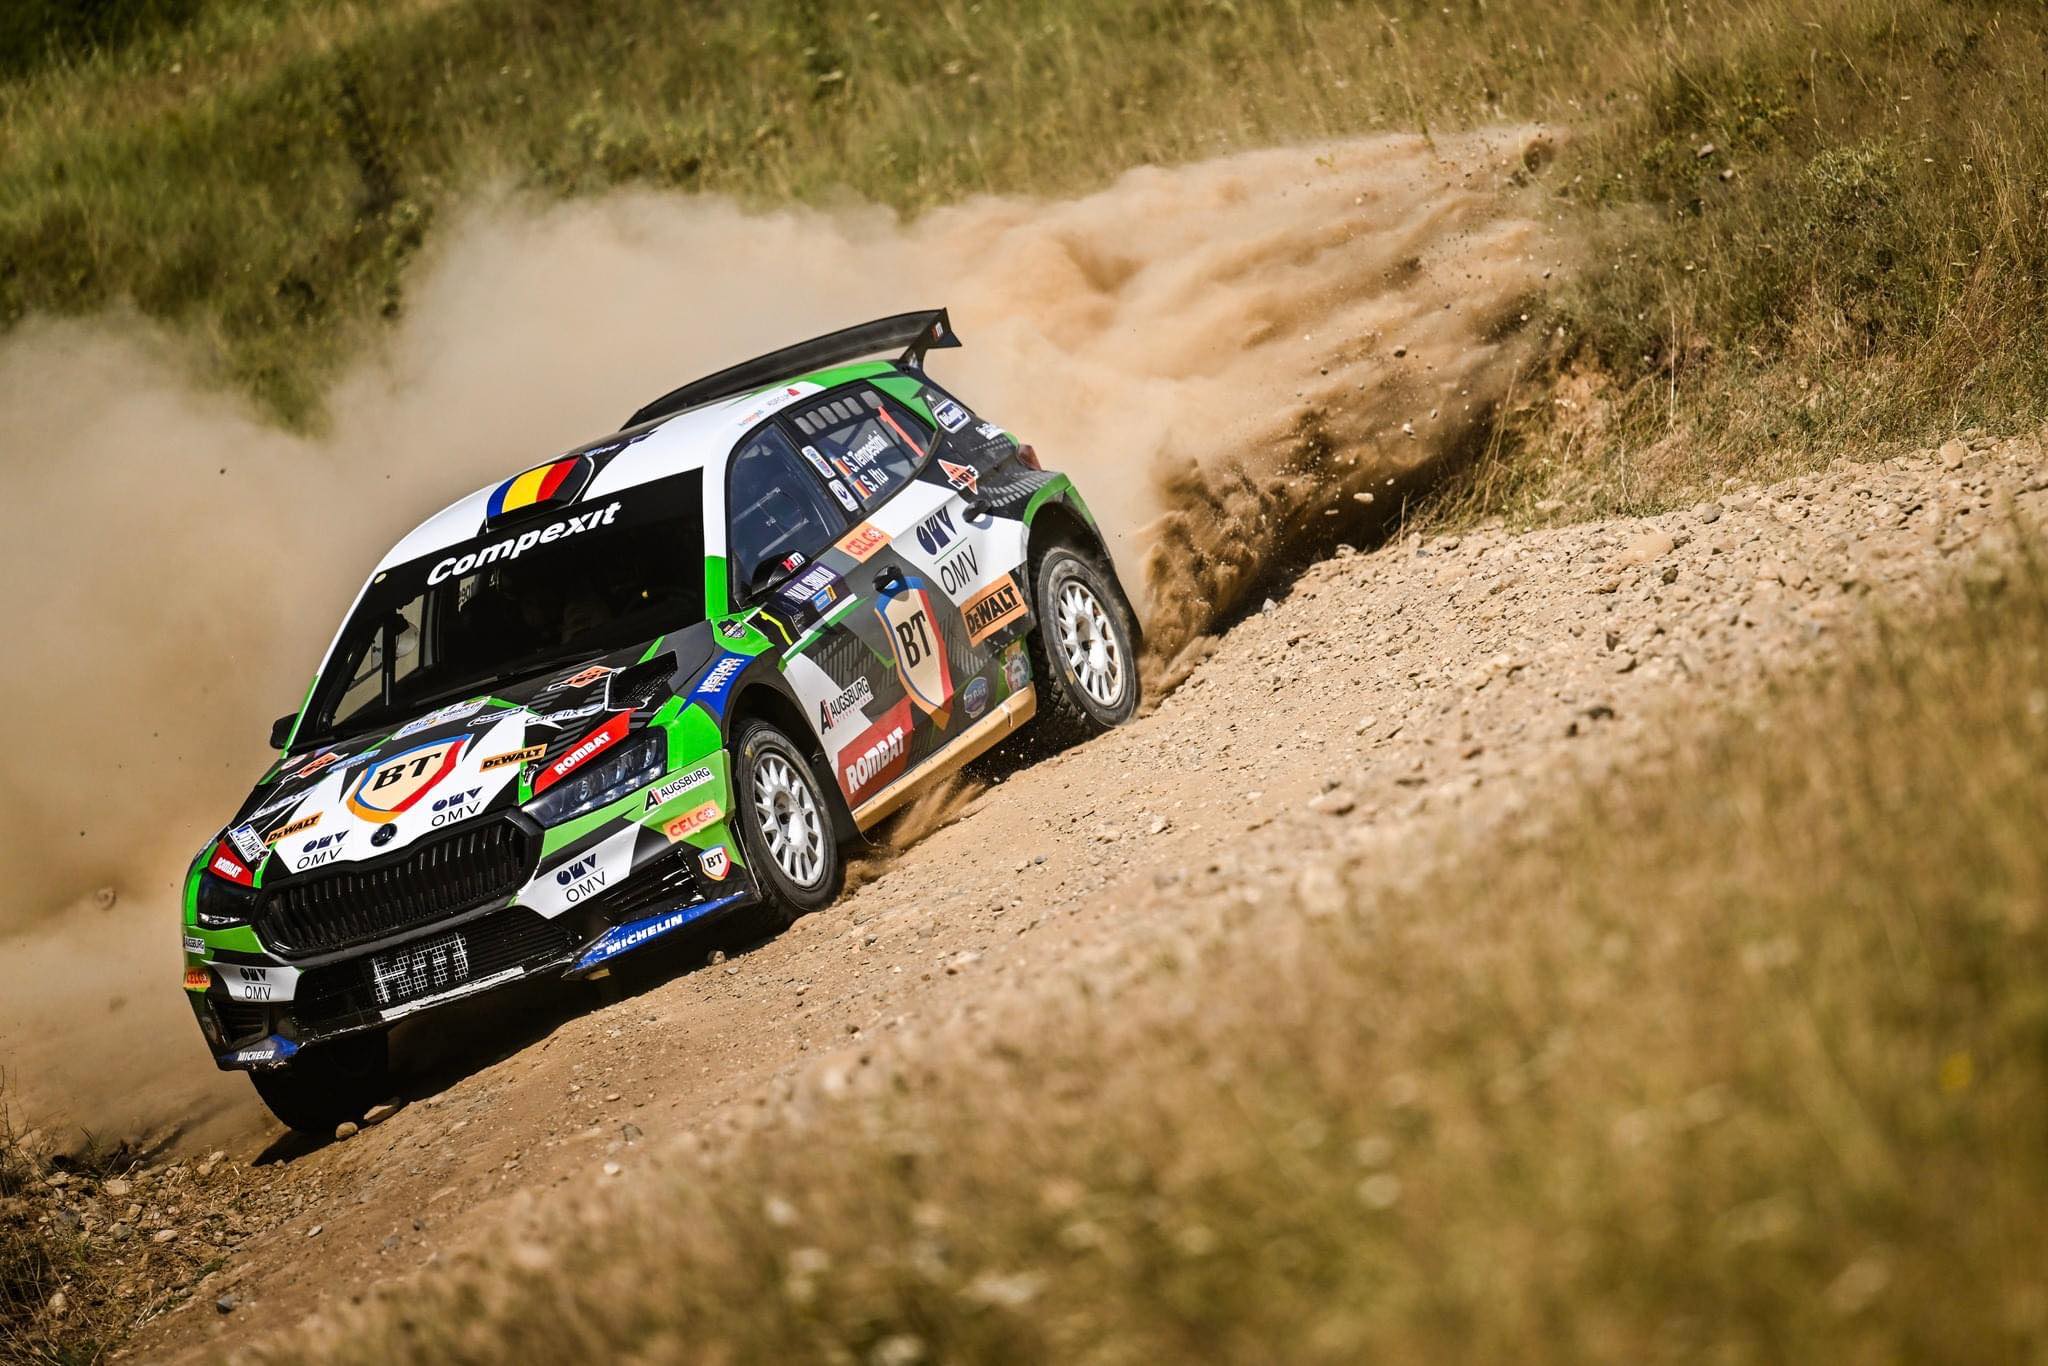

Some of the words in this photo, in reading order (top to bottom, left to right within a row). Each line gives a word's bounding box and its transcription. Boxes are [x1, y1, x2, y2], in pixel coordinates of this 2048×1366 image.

[427, 501, 622, 585] Compexit
[940, 544, 979, 596] OMV
[895, 610, 931, 668] BT
[830, 678, 870, 718] AUGSBURG
[372, 752, 442, 791] BT
[553, 731, 612, 776] ROMBAT
[845, 726, 904, 794] ROMBAT
[660, 767, 711, 797] AUGSBURG
[431, 801, 480, 827] OMV
[297, 847, 342, 869] OMV
[706, 854, 723, 868] BT
[565, 873, 606, 903] OMV
[606, 914, 684, 955] MICHELIN
[245, 985, 271, 1001] OMV
[237, 1050, 275, 1062] MICHELIN
